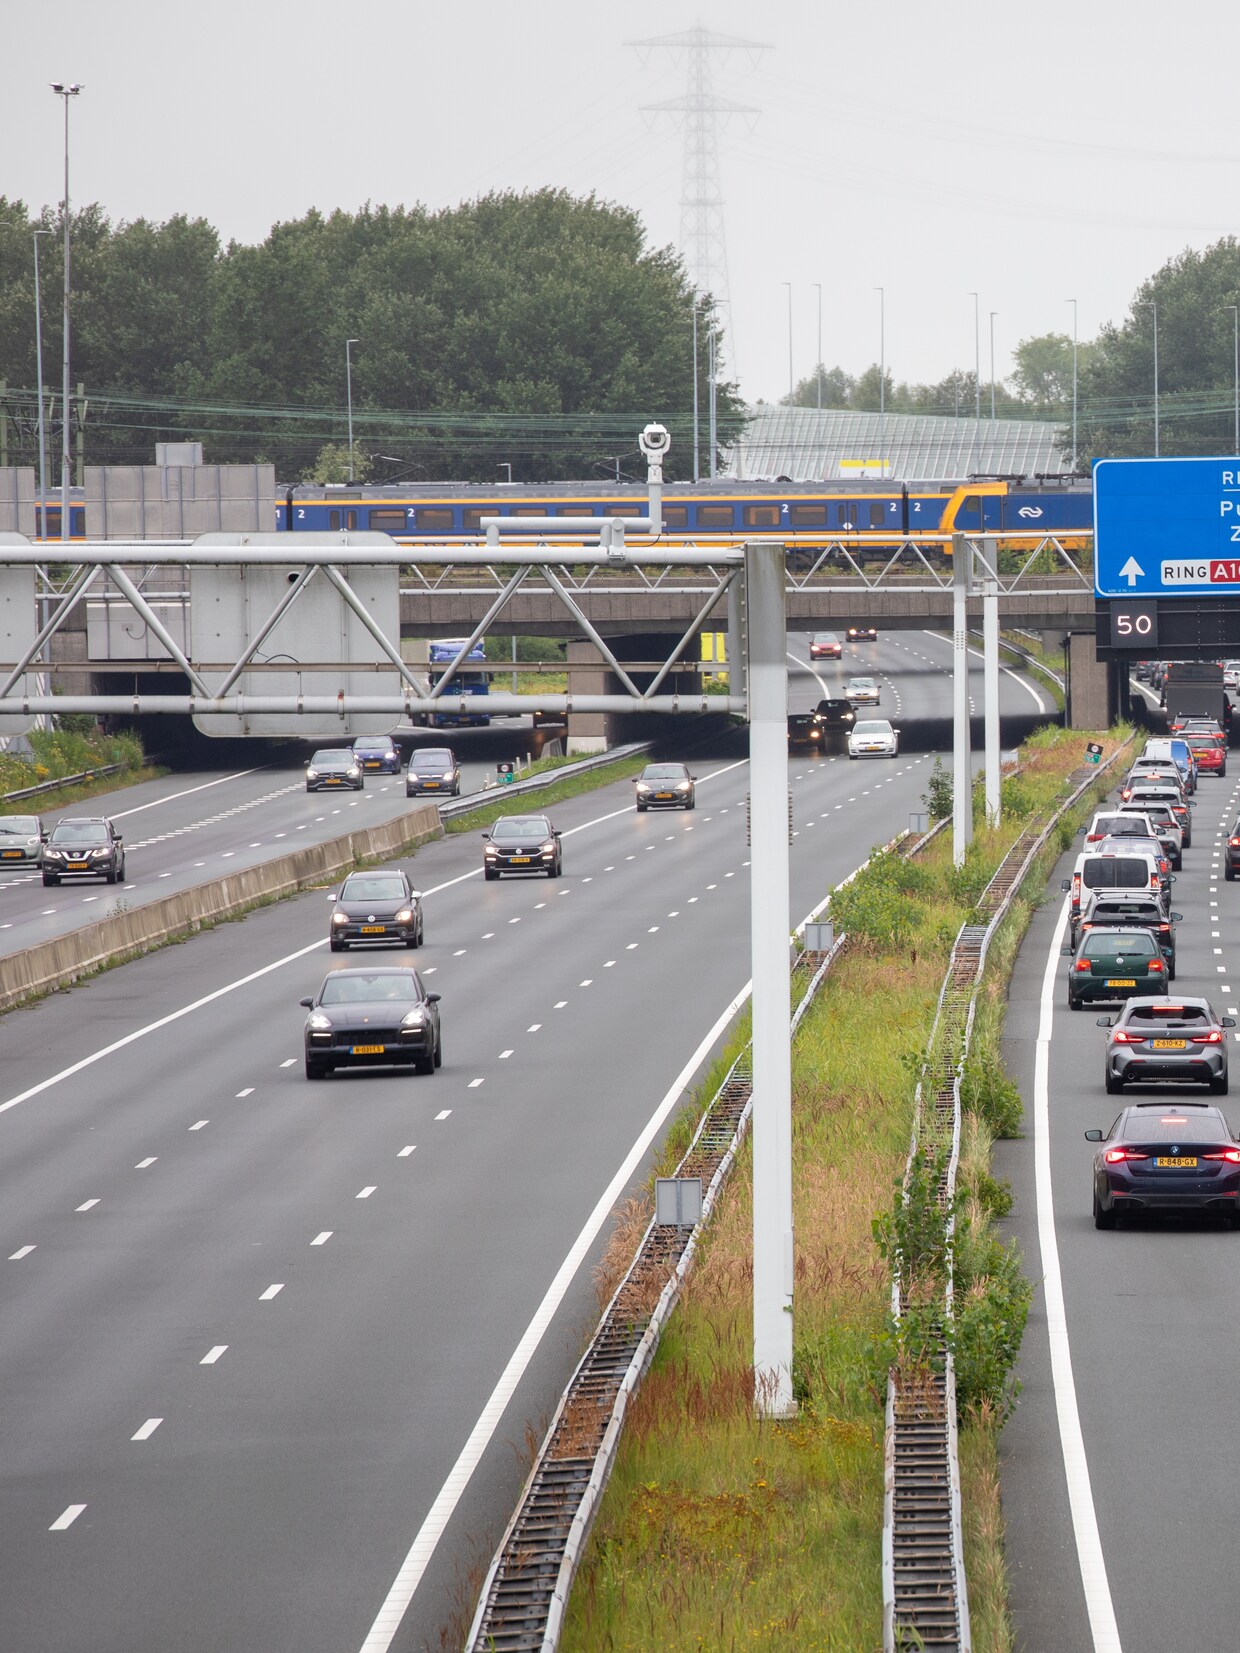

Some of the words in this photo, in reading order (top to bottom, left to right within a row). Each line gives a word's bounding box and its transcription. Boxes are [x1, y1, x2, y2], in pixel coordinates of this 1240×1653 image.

[782, 504, 789, 513] 2
[890, 503, 897, 512] 2
[914, 503, 921, 512] 2
[298, 509, 305, 519] 2
[408, 508, 415, 517] 2
[1164, 565, 1207, 580] RING
[1117, 615, 1152, 635] 50
[1159, 1157, 1196, 1166] R-848-GX
